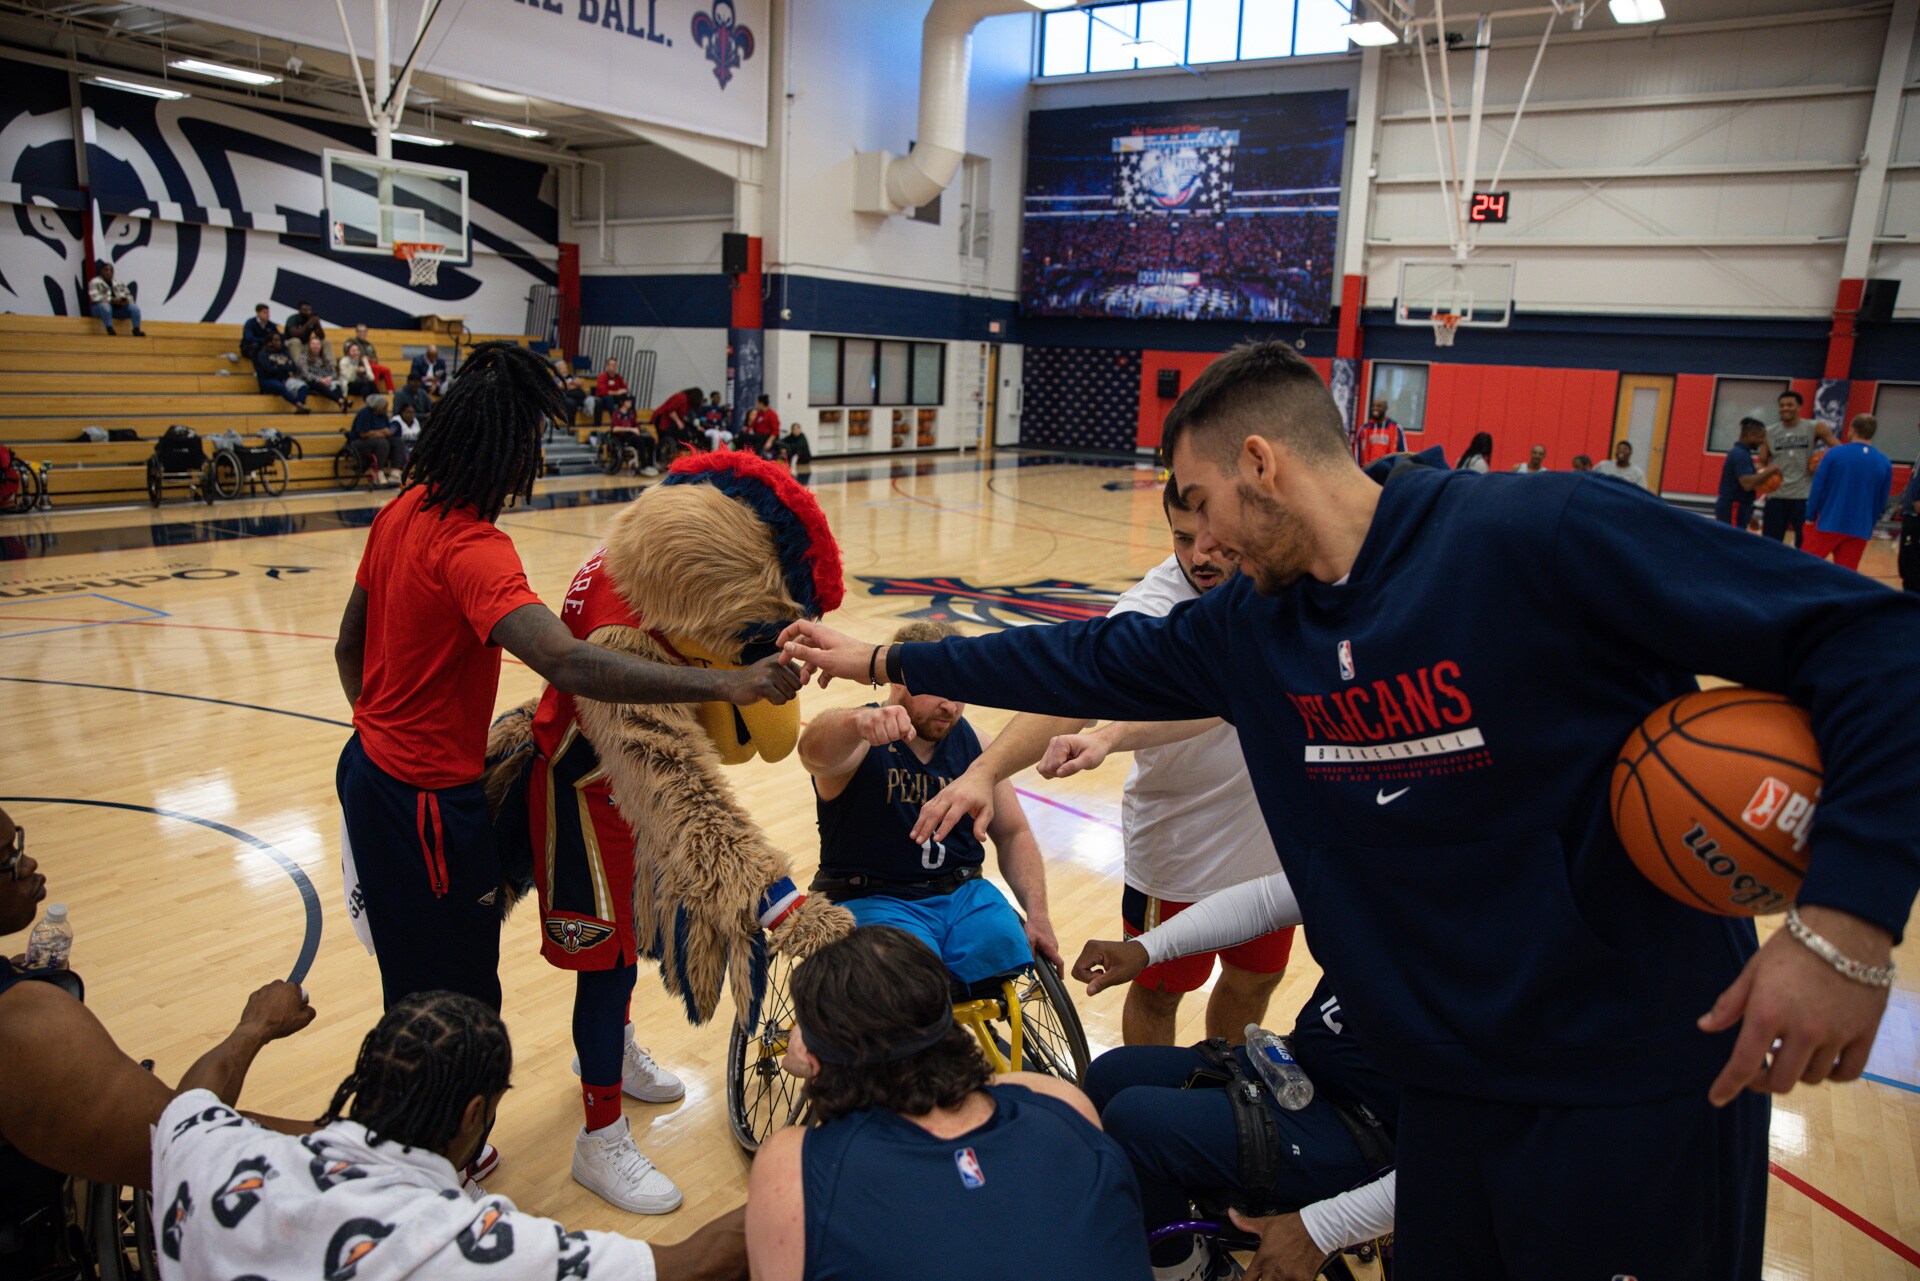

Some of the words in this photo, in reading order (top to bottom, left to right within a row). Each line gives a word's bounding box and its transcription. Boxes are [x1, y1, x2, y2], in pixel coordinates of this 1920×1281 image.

[578, 0, 674, 48] BALL.
[1472, 194, 1505, 221] 24
[1286, 660, 1473, 742] PELICANS
